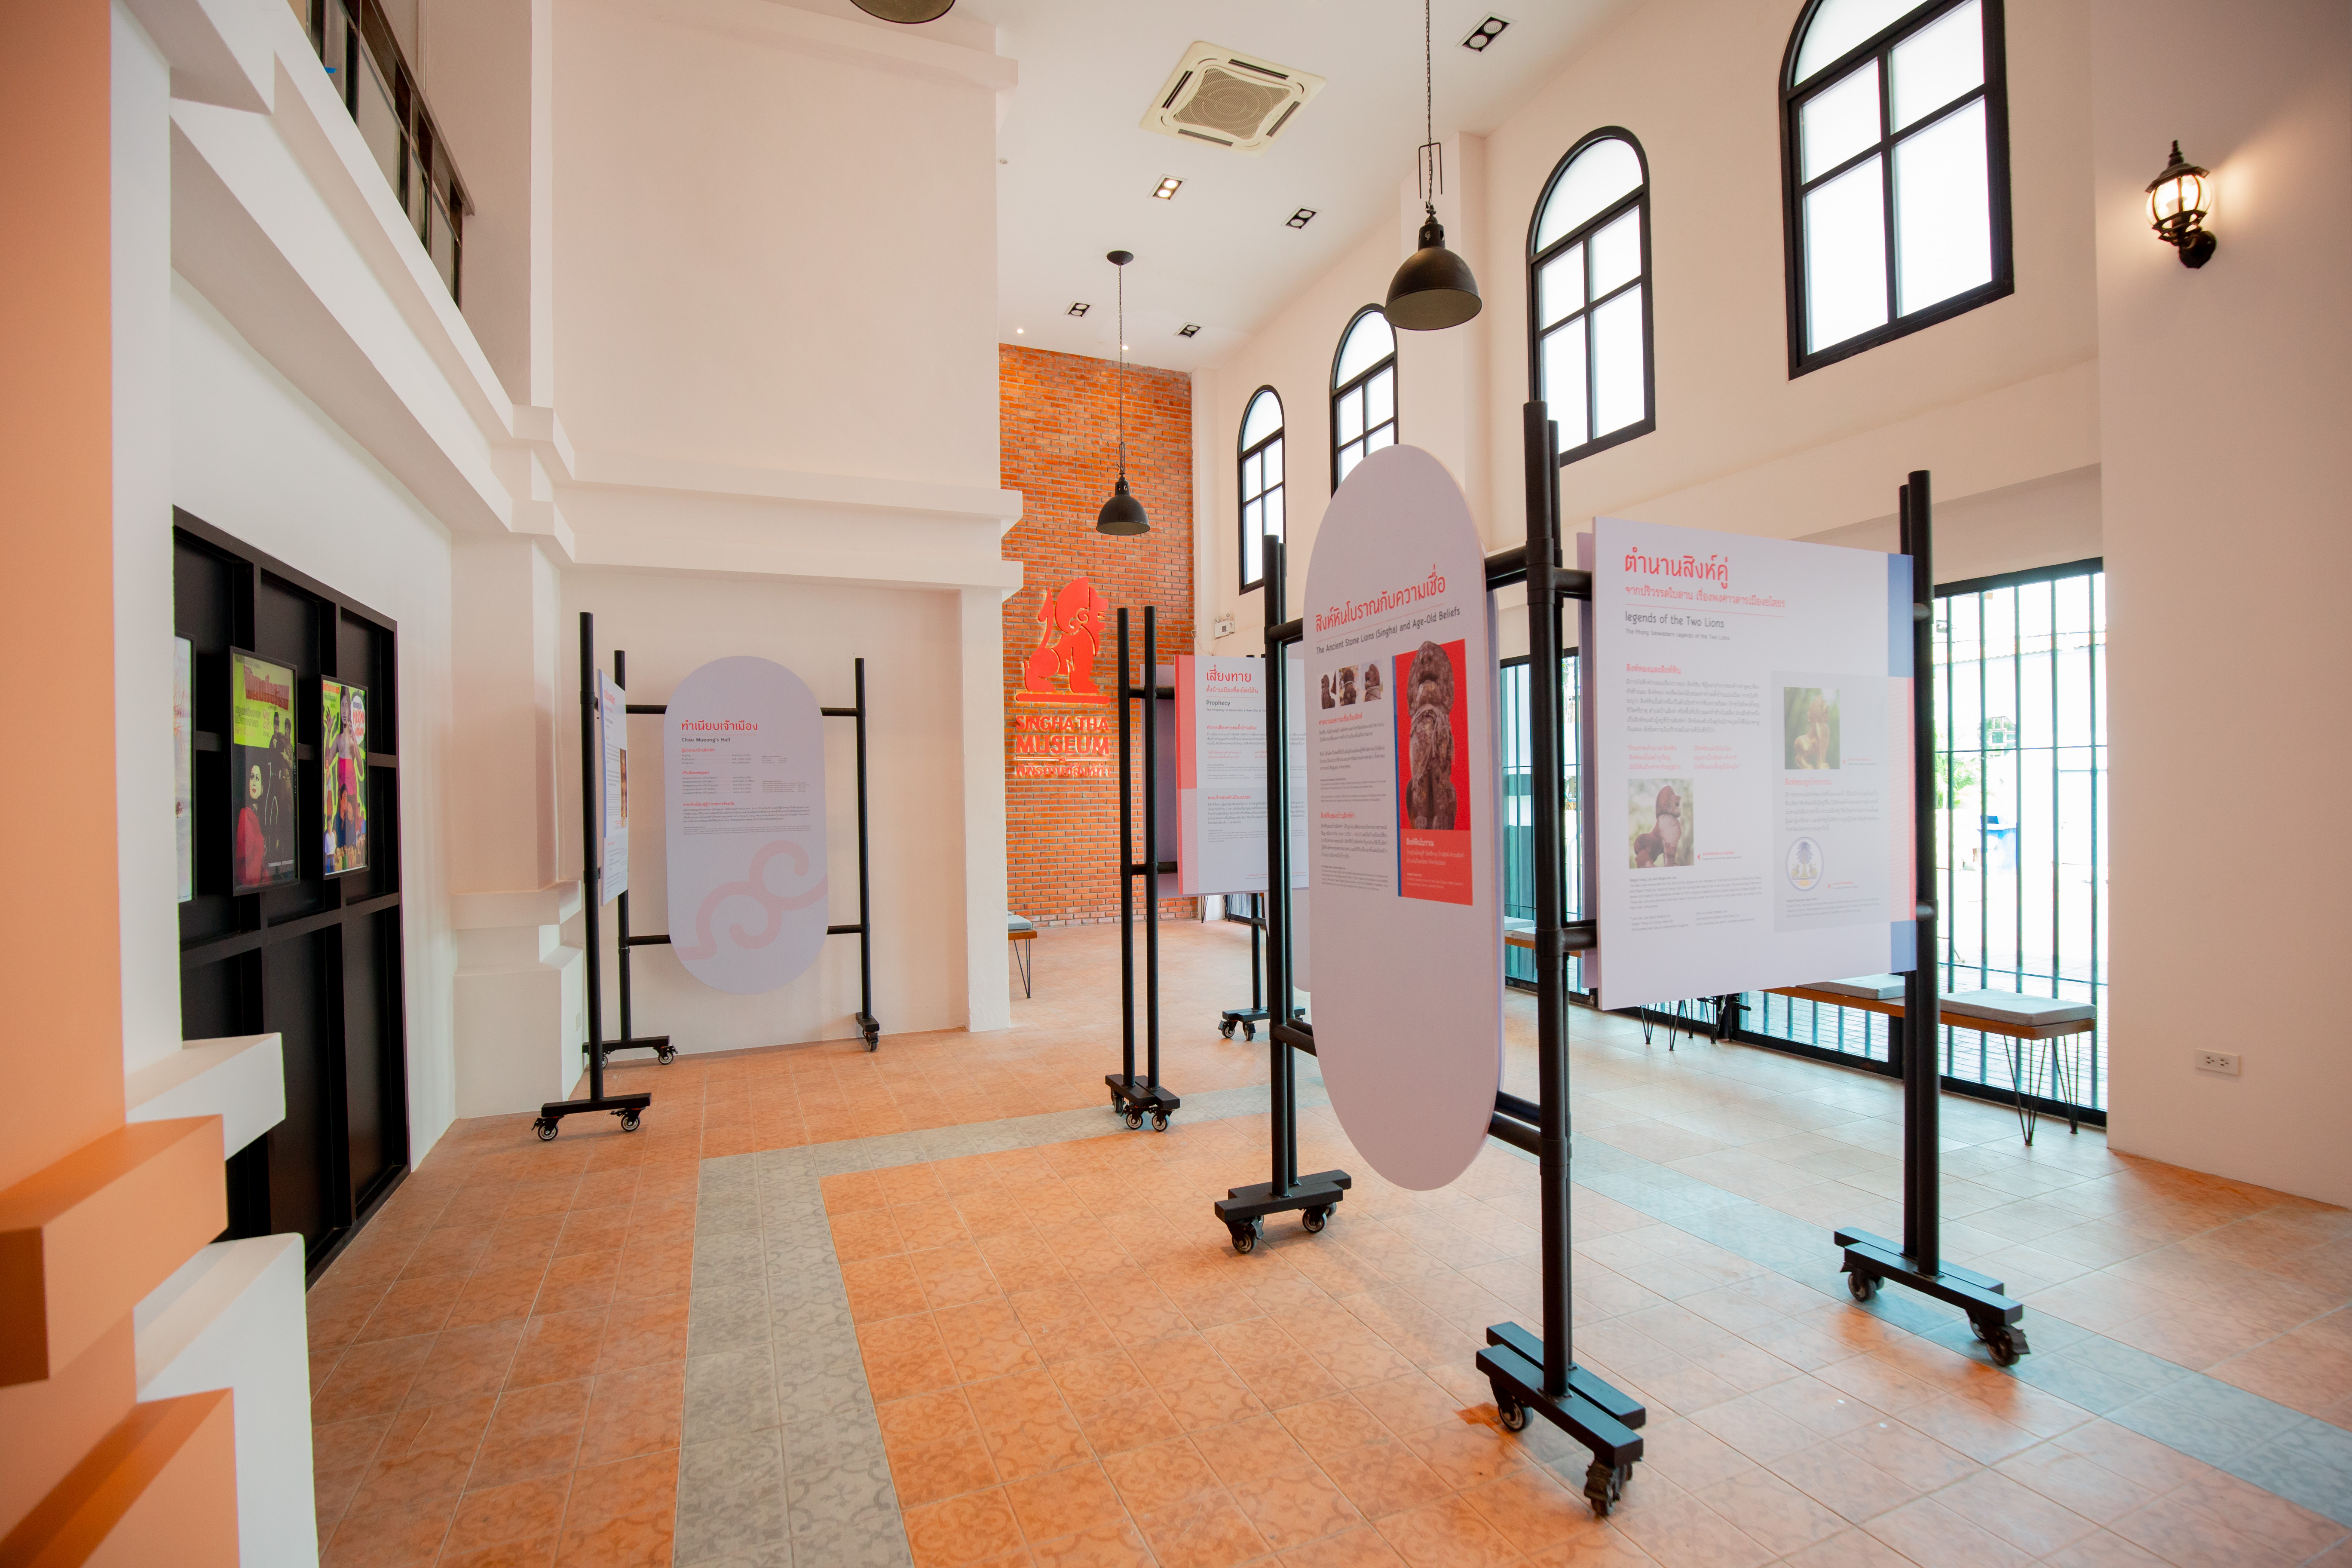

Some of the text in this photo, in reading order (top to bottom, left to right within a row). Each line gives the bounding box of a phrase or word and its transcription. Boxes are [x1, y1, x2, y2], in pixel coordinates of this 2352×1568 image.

[1625, 547, 1728, 589] ตำนานสิงห์คู่
[1315, 564, 1446, 632] สิงห์หินโบราณกับความเชื่อ
[1316, 606, 1460, 654] The Ancient Stone Lions (Singha) and Age-Old Beliefs
[1660, 614, 1668, 624] of
[1670, 615, 1683, 625] the
[1687, 616, 1702, 626] Two
[1705, 618, 1724, 628] Lions
[1206, 665, 1252, 682] เสี่ยงทาย
[681, 720, 758, 731] ทำเนียบเจ้าเมือง
[1016, 715, 1110, 731] SINGHA THA
[1016, 734, 1110, 755] MUSEUM
